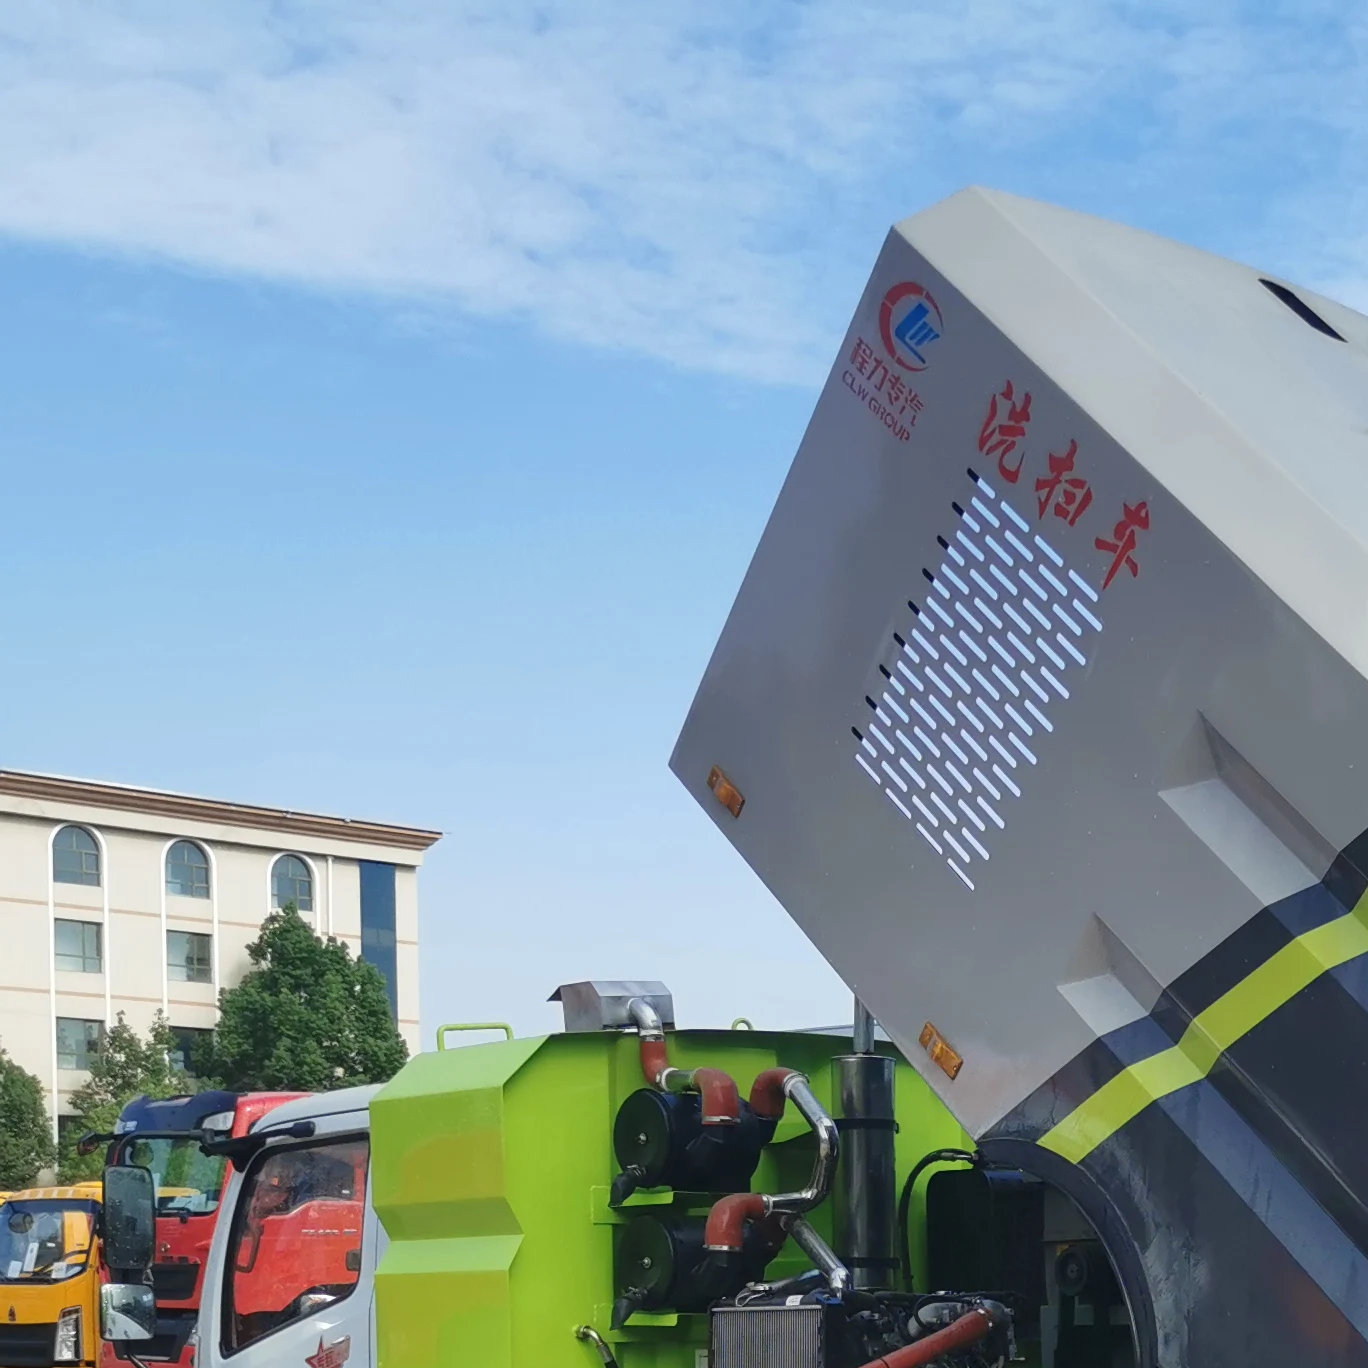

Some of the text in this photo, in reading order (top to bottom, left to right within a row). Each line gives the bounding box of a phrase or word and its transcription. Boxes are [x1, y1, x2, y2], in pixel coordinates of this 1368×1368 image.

[841, 370, 911, 441] CLW GROUP
[850, 335, 925, 427] 程力专汽
[978, 379, 1150, 591] 洗扫车
